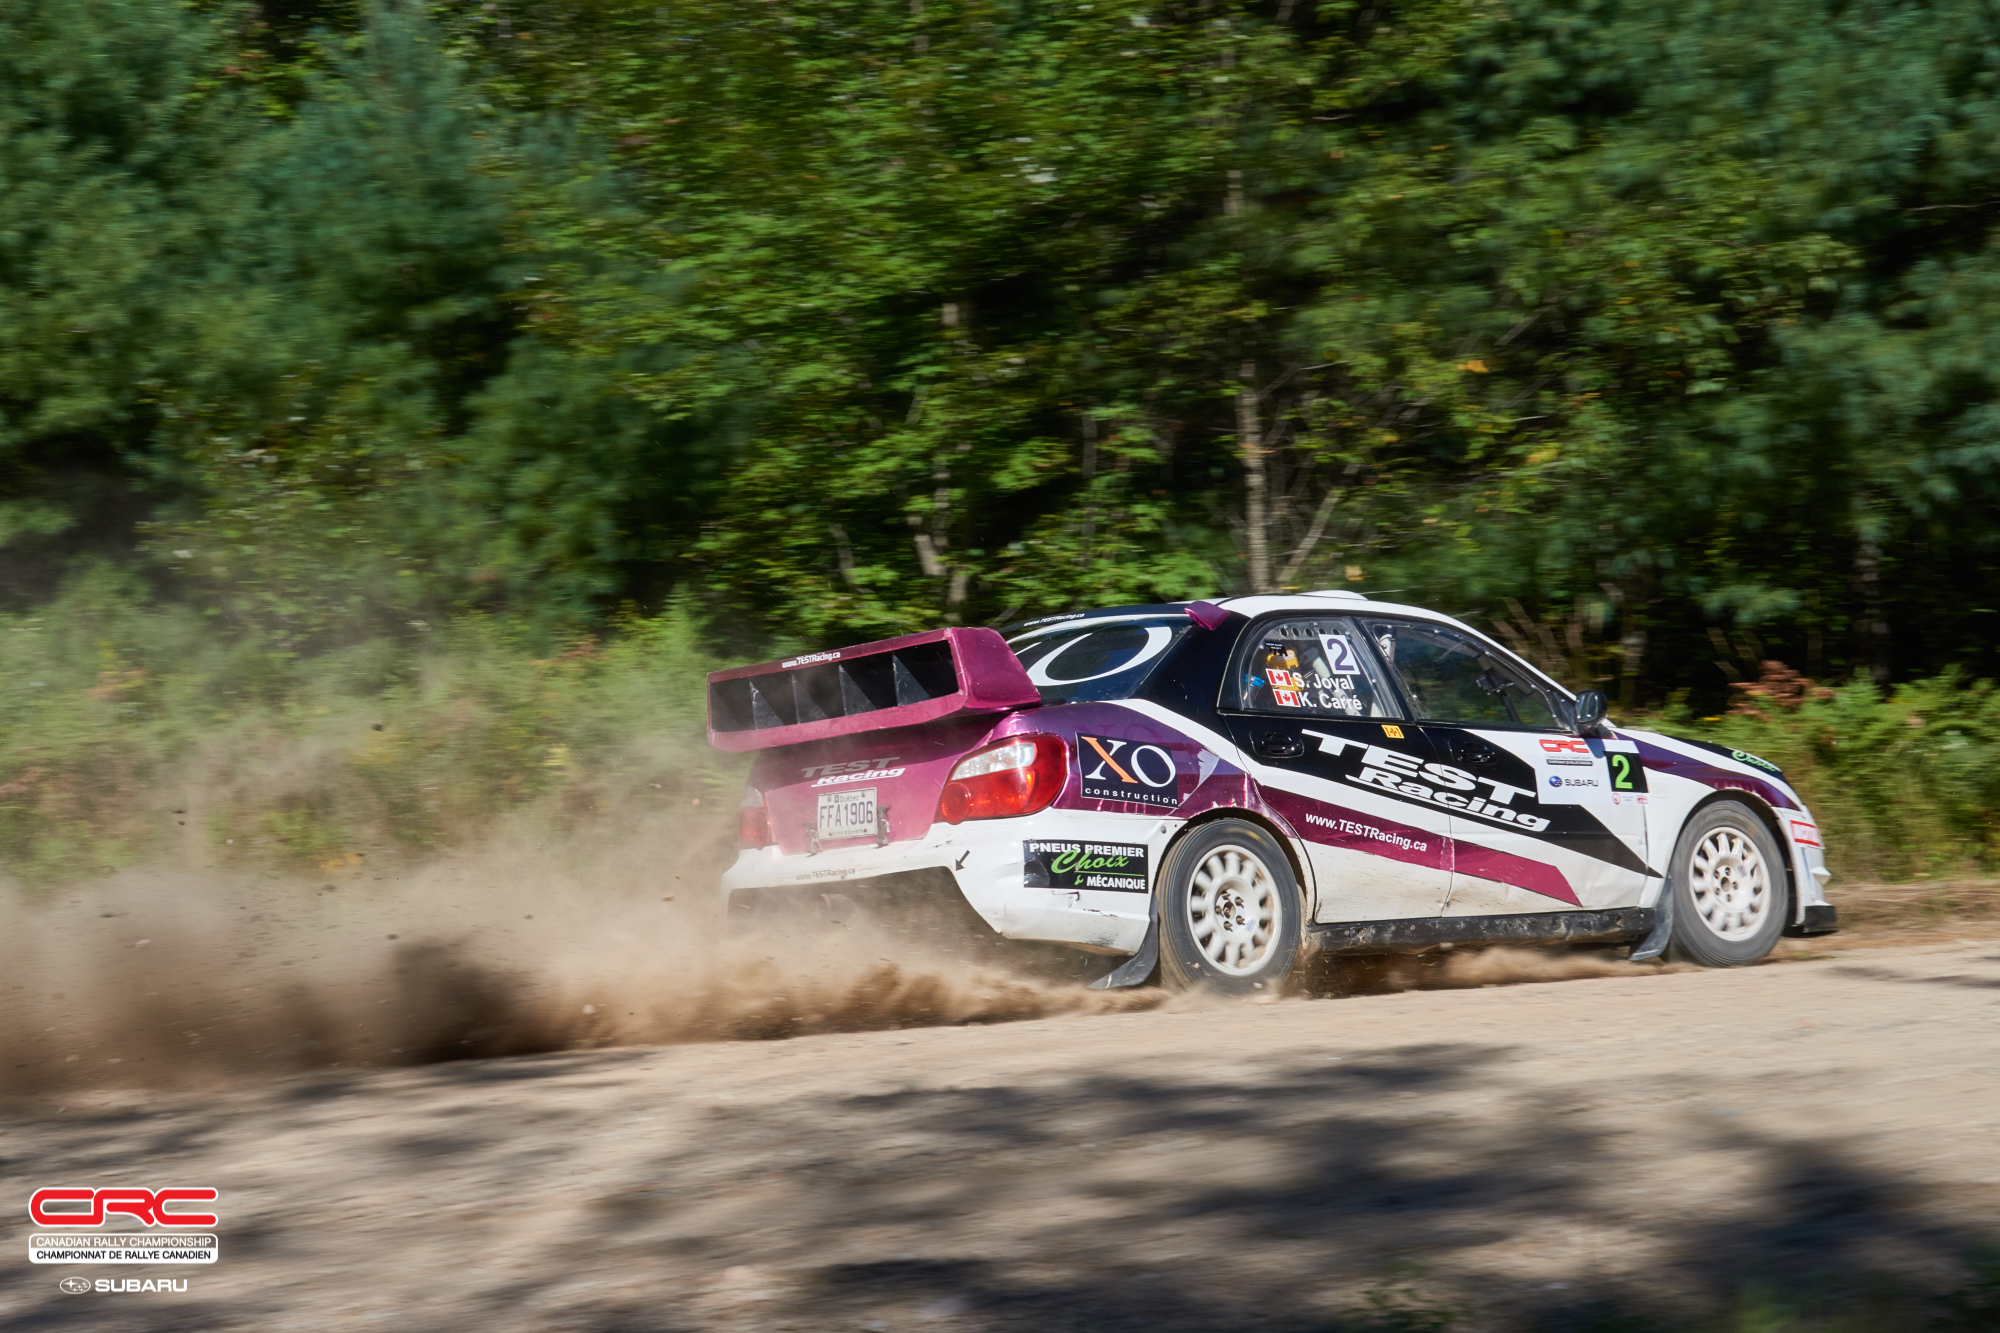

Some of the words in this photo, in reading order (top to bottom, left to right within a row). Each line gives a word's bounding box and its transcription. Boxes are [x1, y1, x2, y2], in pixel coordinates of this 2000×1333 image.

[1327, 638, 1355, 671] 2
[1292, 672, 1311, 688] S.
[1313, 673, 1355, 693] Joyal
[1298, 691, 1317, 708] K.
[1319, 694, 1363, 711] Carré
[1539, 739, 1589, 753] CRC
[801, 757, 900, 778] TEST
[1081, 736, 1176, 788] XO
[1301, 729, 1536, 805] TEST
[1612, 754, 1633, 790] 2
[816, 767, 906, 786] Racing
[1564, 778, 1599, 787] SUBARU
[1085, 787, 1178, 805] construction
[1359, 766, 1551, 832] Racing
[819, 801, 873, 829] FFA1906
[1305, 813, 1428, 852] www.TESTRacing.ca
[1029, 842, 1081, 853] PNEUS
[1084, 844, 1144, 857] PREMIER
[1051, 849, 1129, 874] Choix
[1086, 874, 1146, 890] MÉCANIQUE
